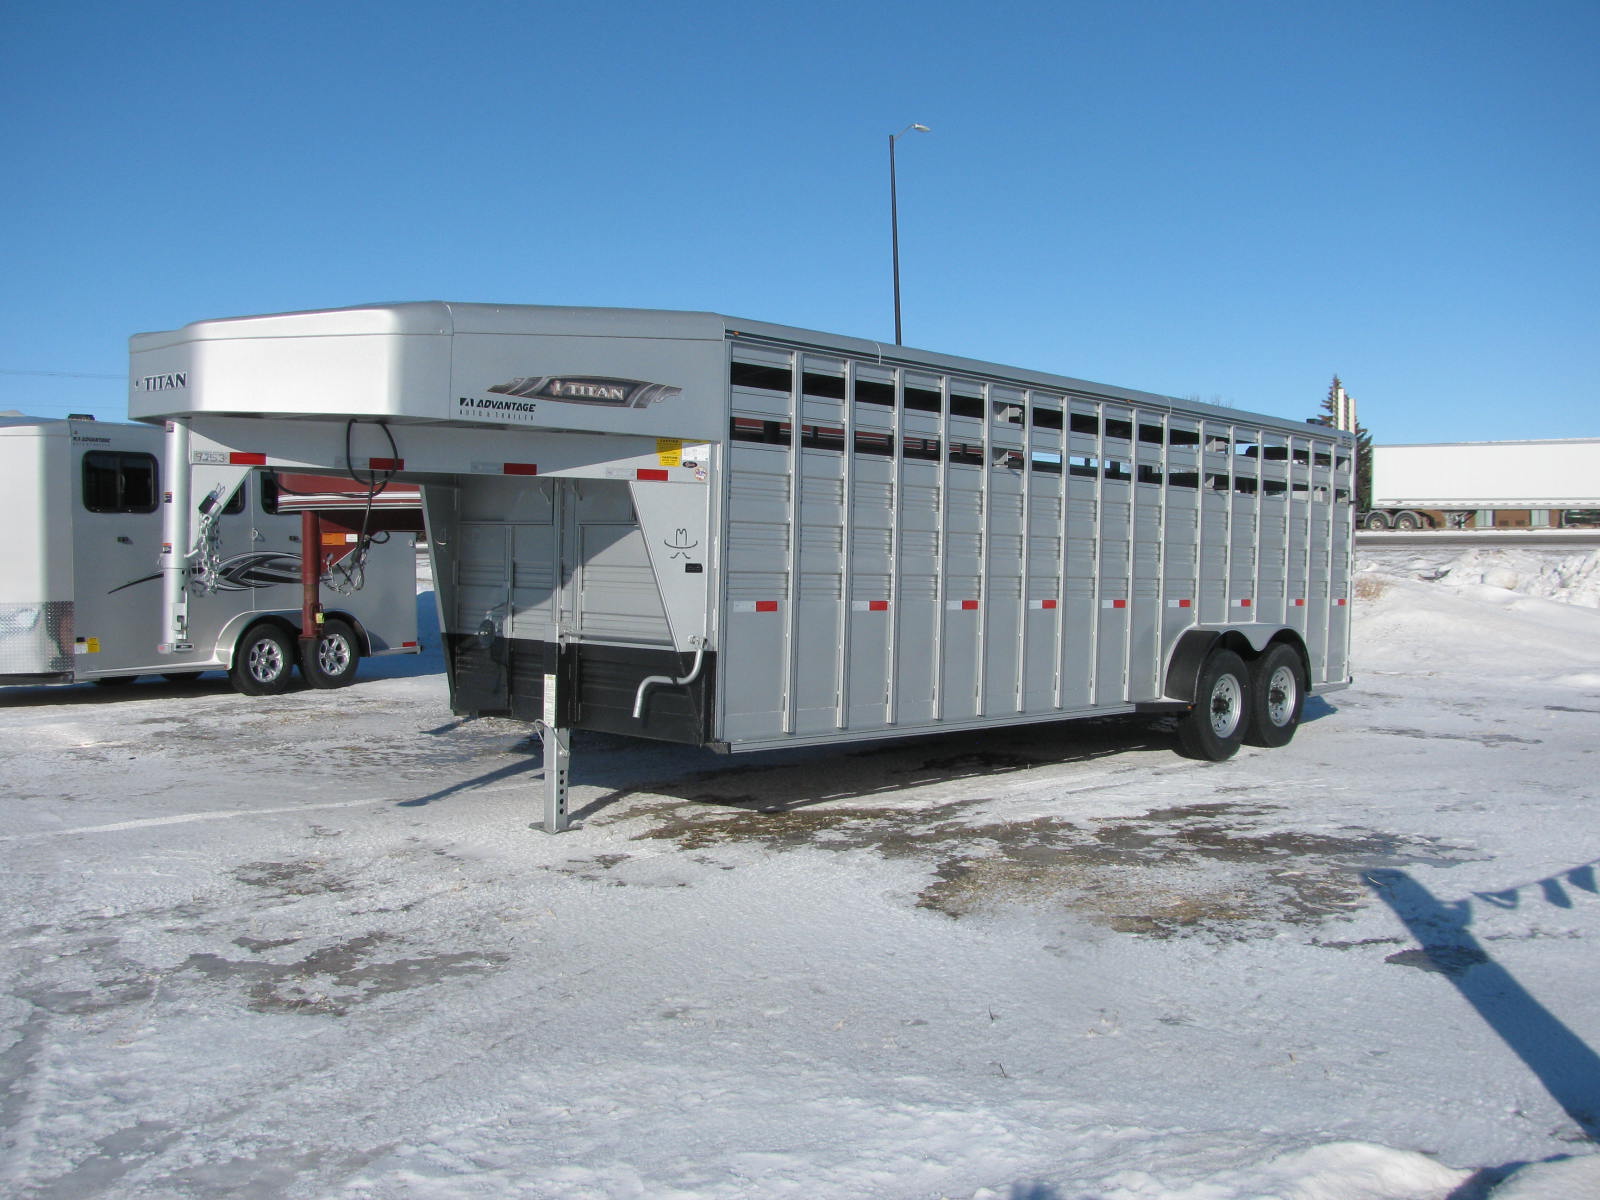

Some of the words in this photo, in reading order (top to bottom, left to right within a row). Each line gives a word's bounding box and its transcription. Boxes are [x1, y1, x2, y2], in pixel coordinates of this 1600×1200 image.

[143, 372, 187, 391] TITAN
[565, 382, 625, 401] TITAN
[476, 399, 537, 413] ADVANTAGE
